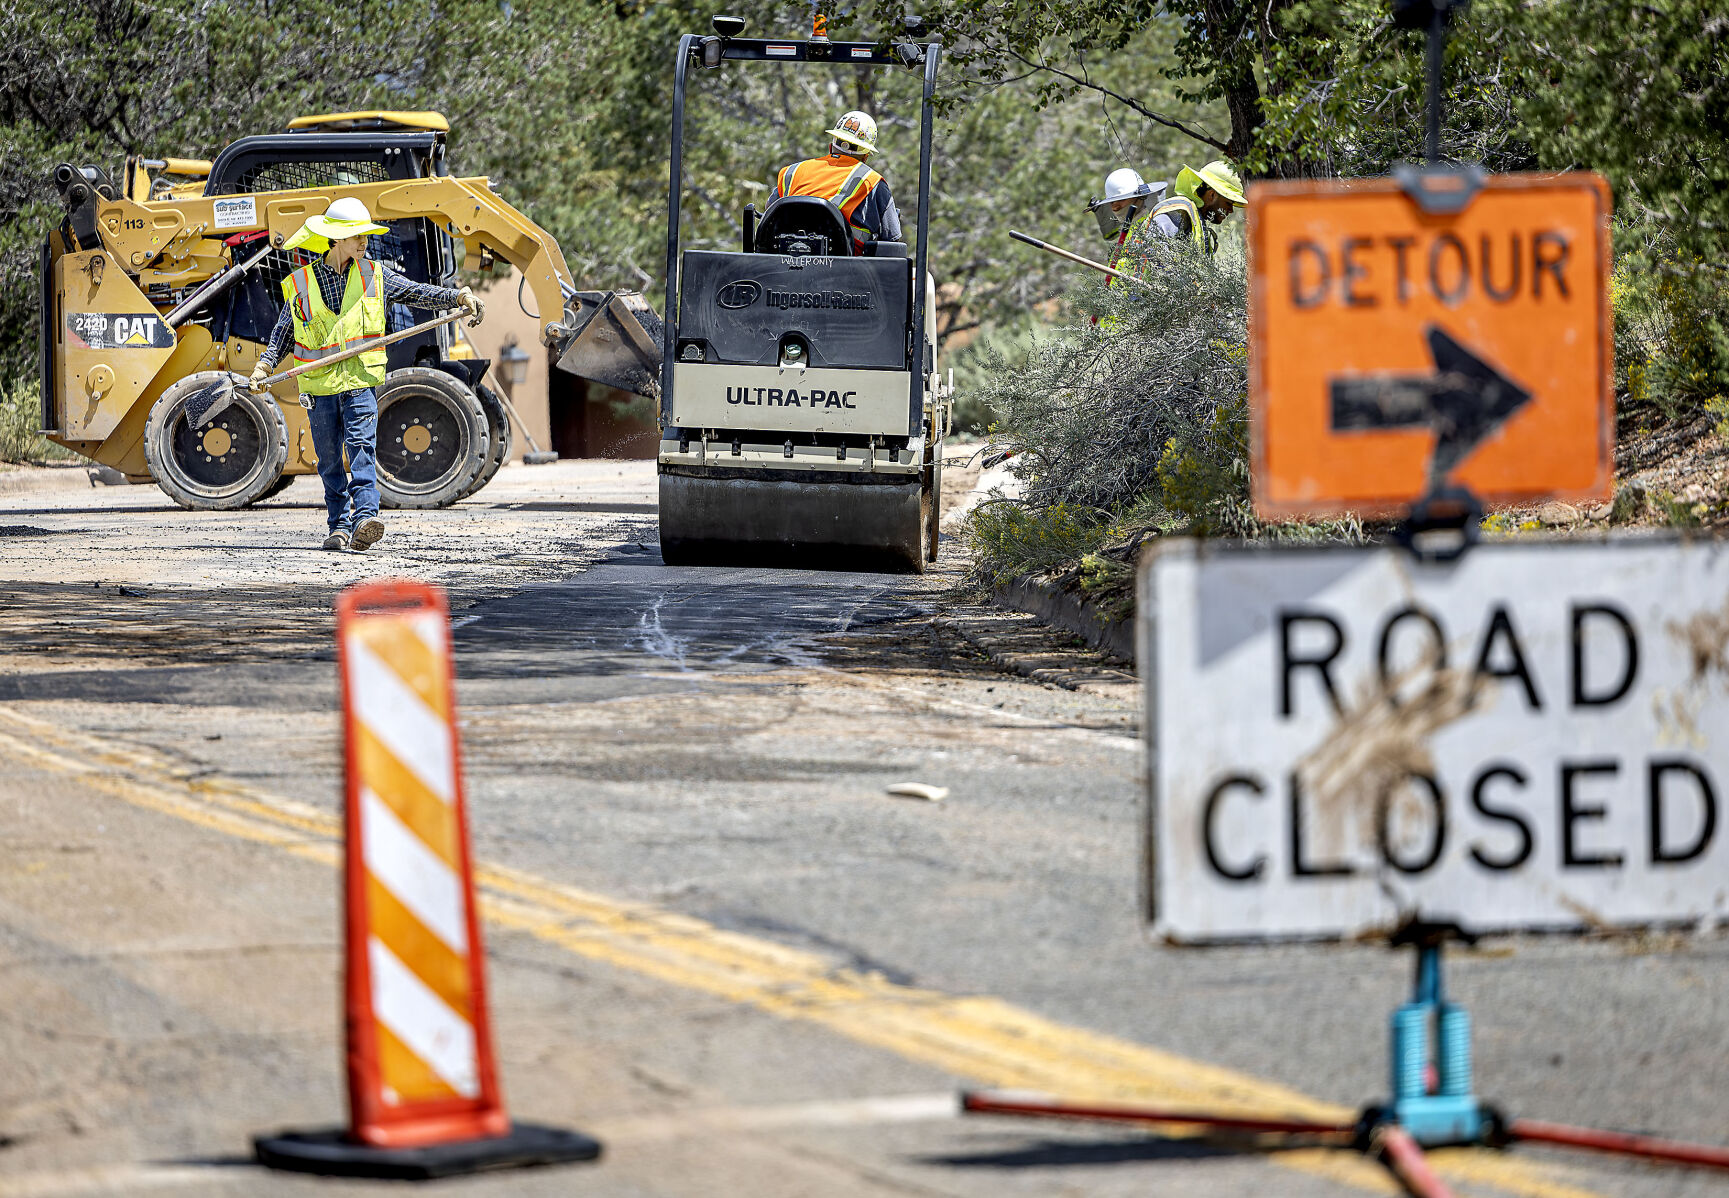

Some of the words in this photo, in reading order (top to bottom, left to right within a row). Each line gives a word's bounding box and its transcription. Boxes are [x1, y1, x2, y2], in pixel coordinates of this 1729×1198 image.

[124, 219, 144, 229] 113
[1287, 230, 1571, 308] DETOUR
[76, 317, 108, 332] 242D
[114, 317, 158, 345] CAT
[726, 386, 857, 409] ULTRA-PAC
[1276, 603, 1640, 717] ROAD
[1202, 757, 1717, 882] CLOSED
